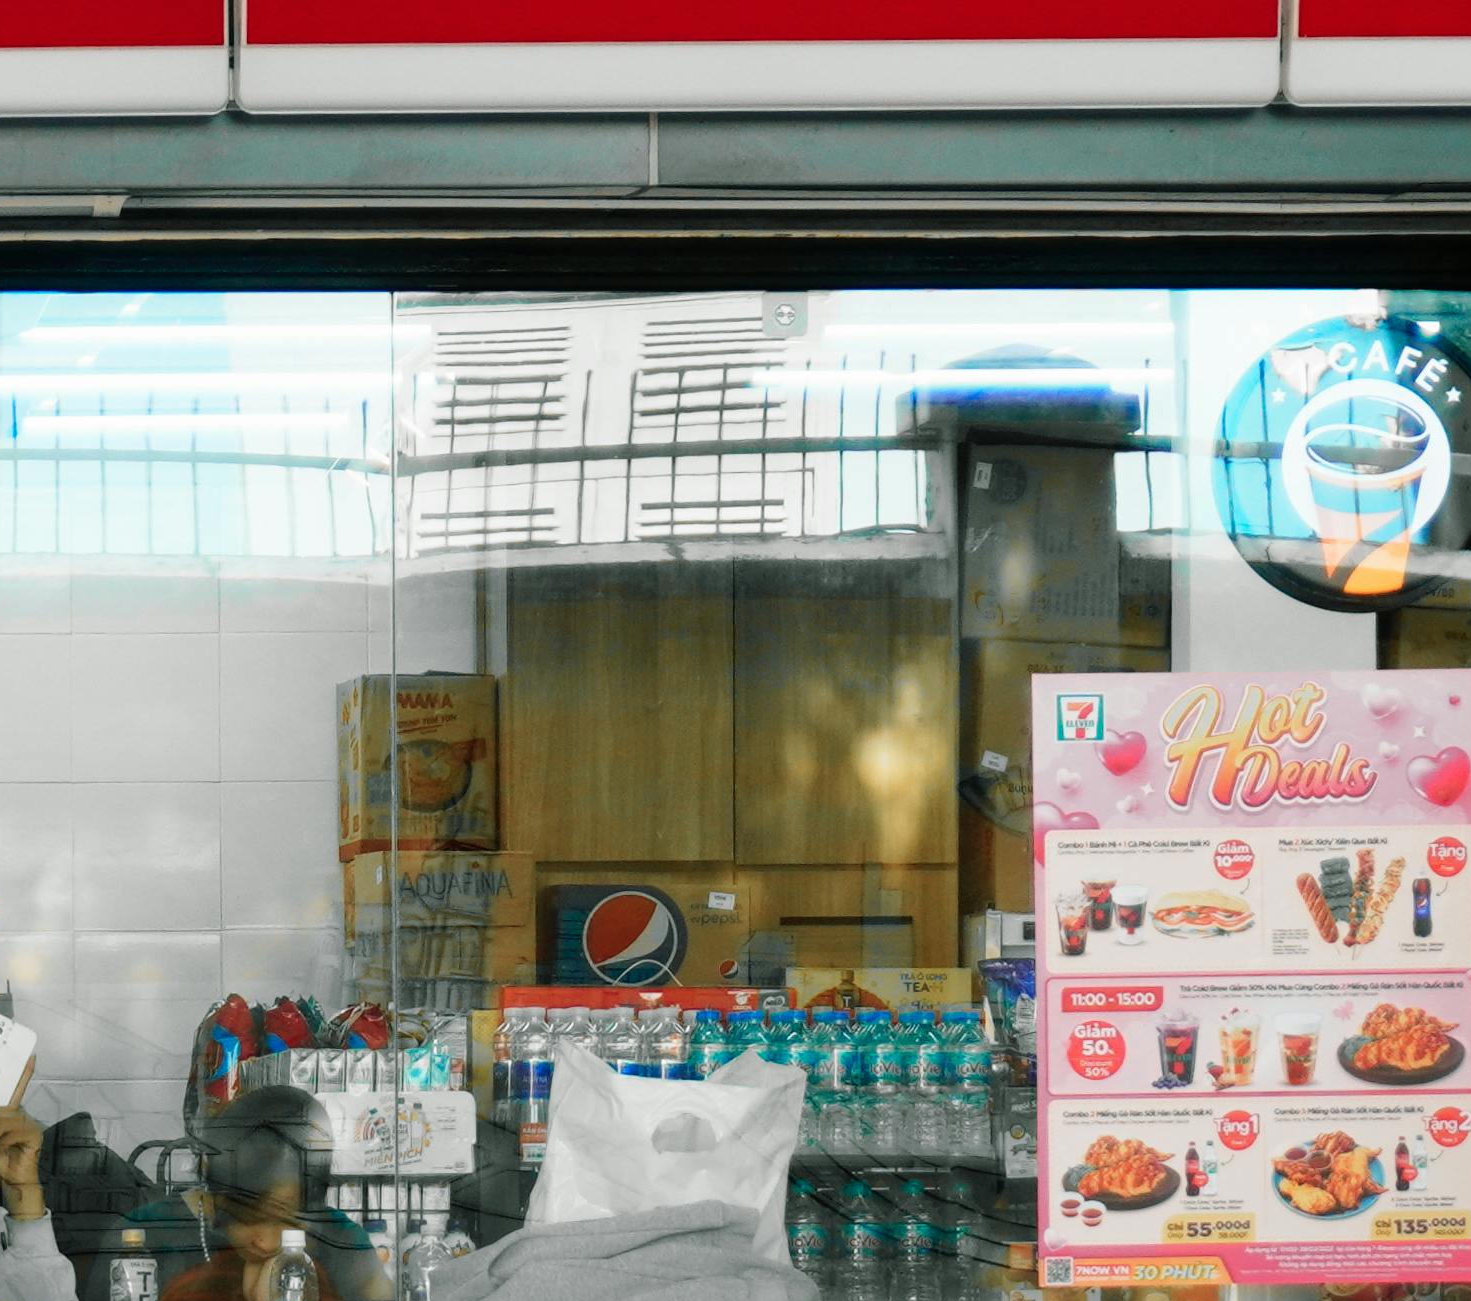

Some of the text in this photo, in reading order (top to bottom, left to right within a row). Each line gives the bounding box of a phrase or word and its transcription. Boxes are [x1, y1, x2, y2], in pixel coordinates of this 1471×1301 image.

[1328, 339, 1449, 393] CAFÉ
[1161, 681, 1324, 807] Hot
[1235, 742, 1379, 808] Deals
[1427, 842, 1466, 863] Tặng
[398, 868, 513, 902] AQUAFINA
[1070, 992, 1107, 1006] 11:00
[1116, 991, 1156, 1006] 15:00
[1074, 1022, 1117, 1038] Giảm
[1213, 1117, 1249, 1136] Tặng
[1422, 1114, 1459, 1134] Tặng
[1133, 1260, 1213, 1281] 30 PHÚT
